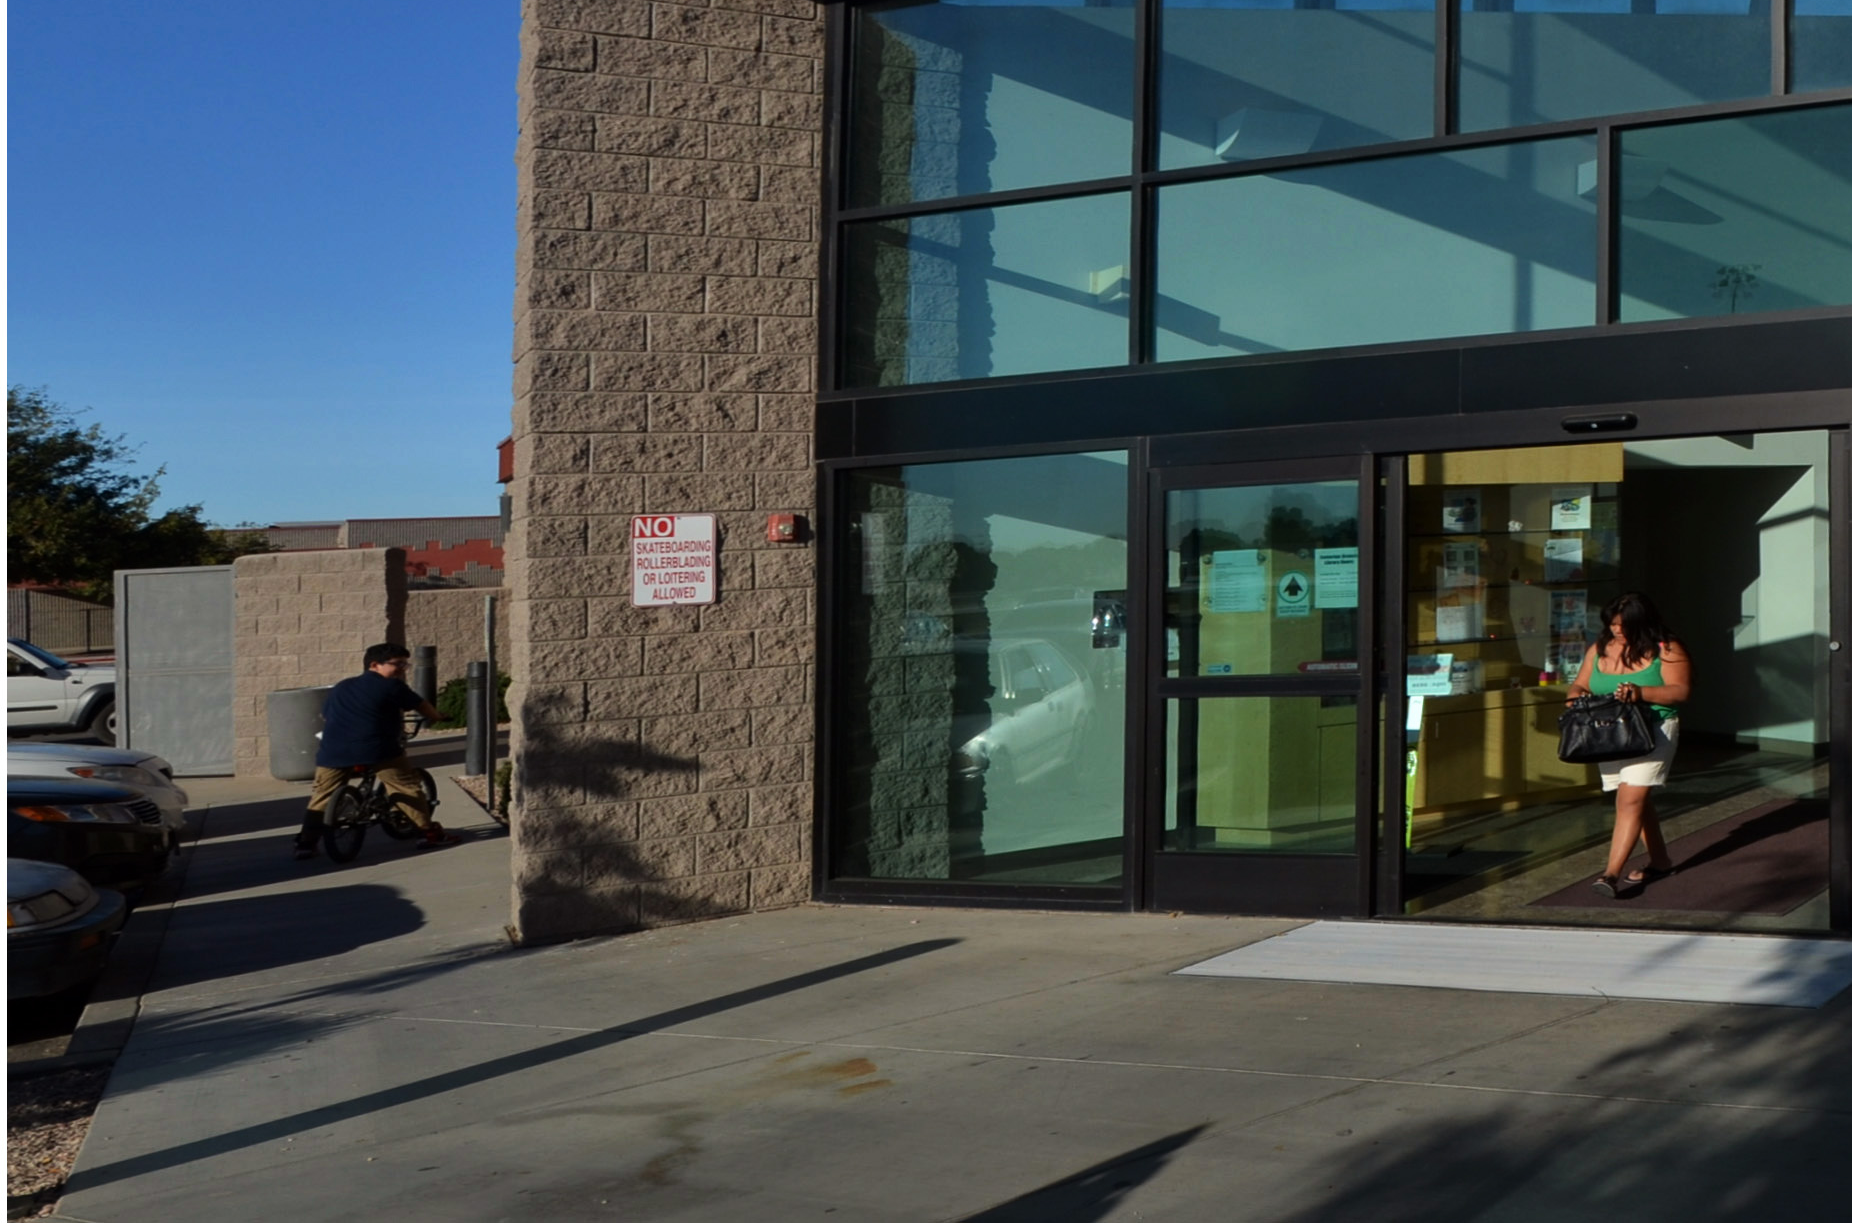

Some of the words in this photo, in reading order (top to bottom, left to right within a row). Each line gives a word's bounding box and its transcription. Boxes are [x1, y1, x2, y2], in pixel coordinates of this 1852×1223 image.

[634, 518, 673, 537] NO
[636, 540, 711, 555] SKATEBOARDING
[637, 555, 711, 570] ROLLERBLADING
[643, 573, 656, 585] OR
[658, 571, 705, 584] LOITERING
[652, 586, 696, 600] ALLOWED
